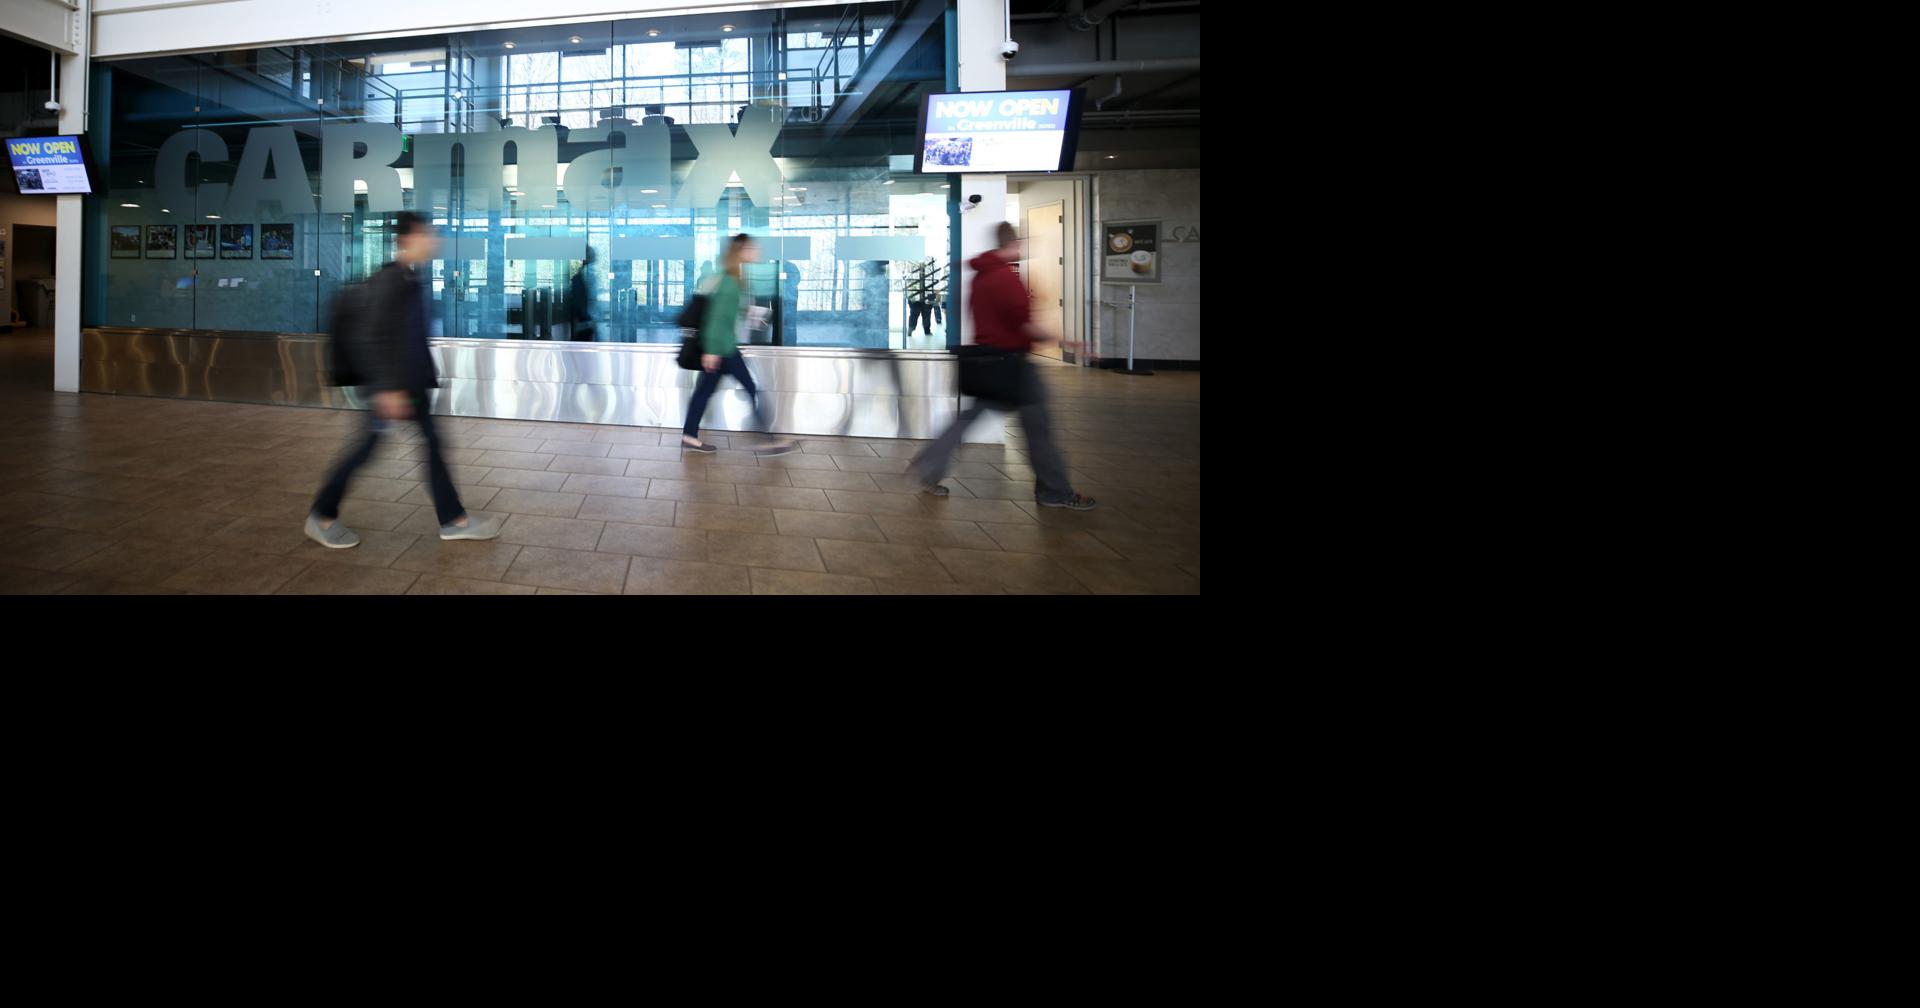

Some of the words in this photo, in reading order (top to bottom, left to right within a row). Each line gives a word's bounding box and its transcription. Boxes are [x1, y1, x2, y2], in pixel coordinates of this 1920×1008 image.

[937, 101, 994, 119] NOW
[999, 98, 1060, 117] OPEN
[956, 117, 1037, 131] Greenville
[10, 143, 40, 155] NOW
[43, 141, 76, 154] OPEN
[26, 154, 69, 165] Greenville
